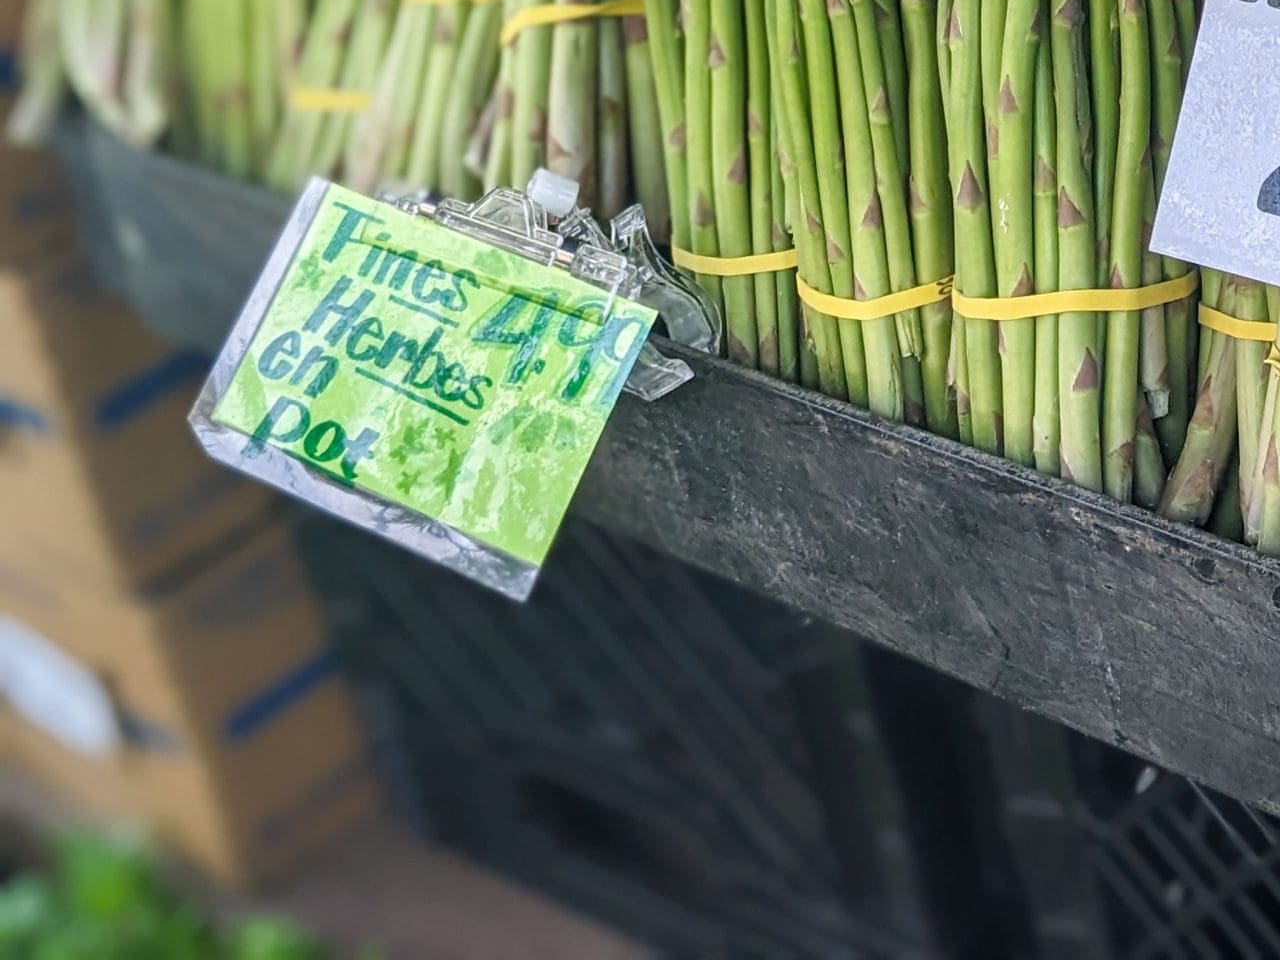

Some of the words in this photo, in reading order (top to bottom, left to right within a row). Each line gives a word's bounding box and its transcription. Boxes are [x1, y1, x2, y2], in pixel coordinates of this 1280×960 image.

[321, 201, 481, 314] Fines
[257, 328, 339, 400] en
[302, 276, 494, 410] Herbes
